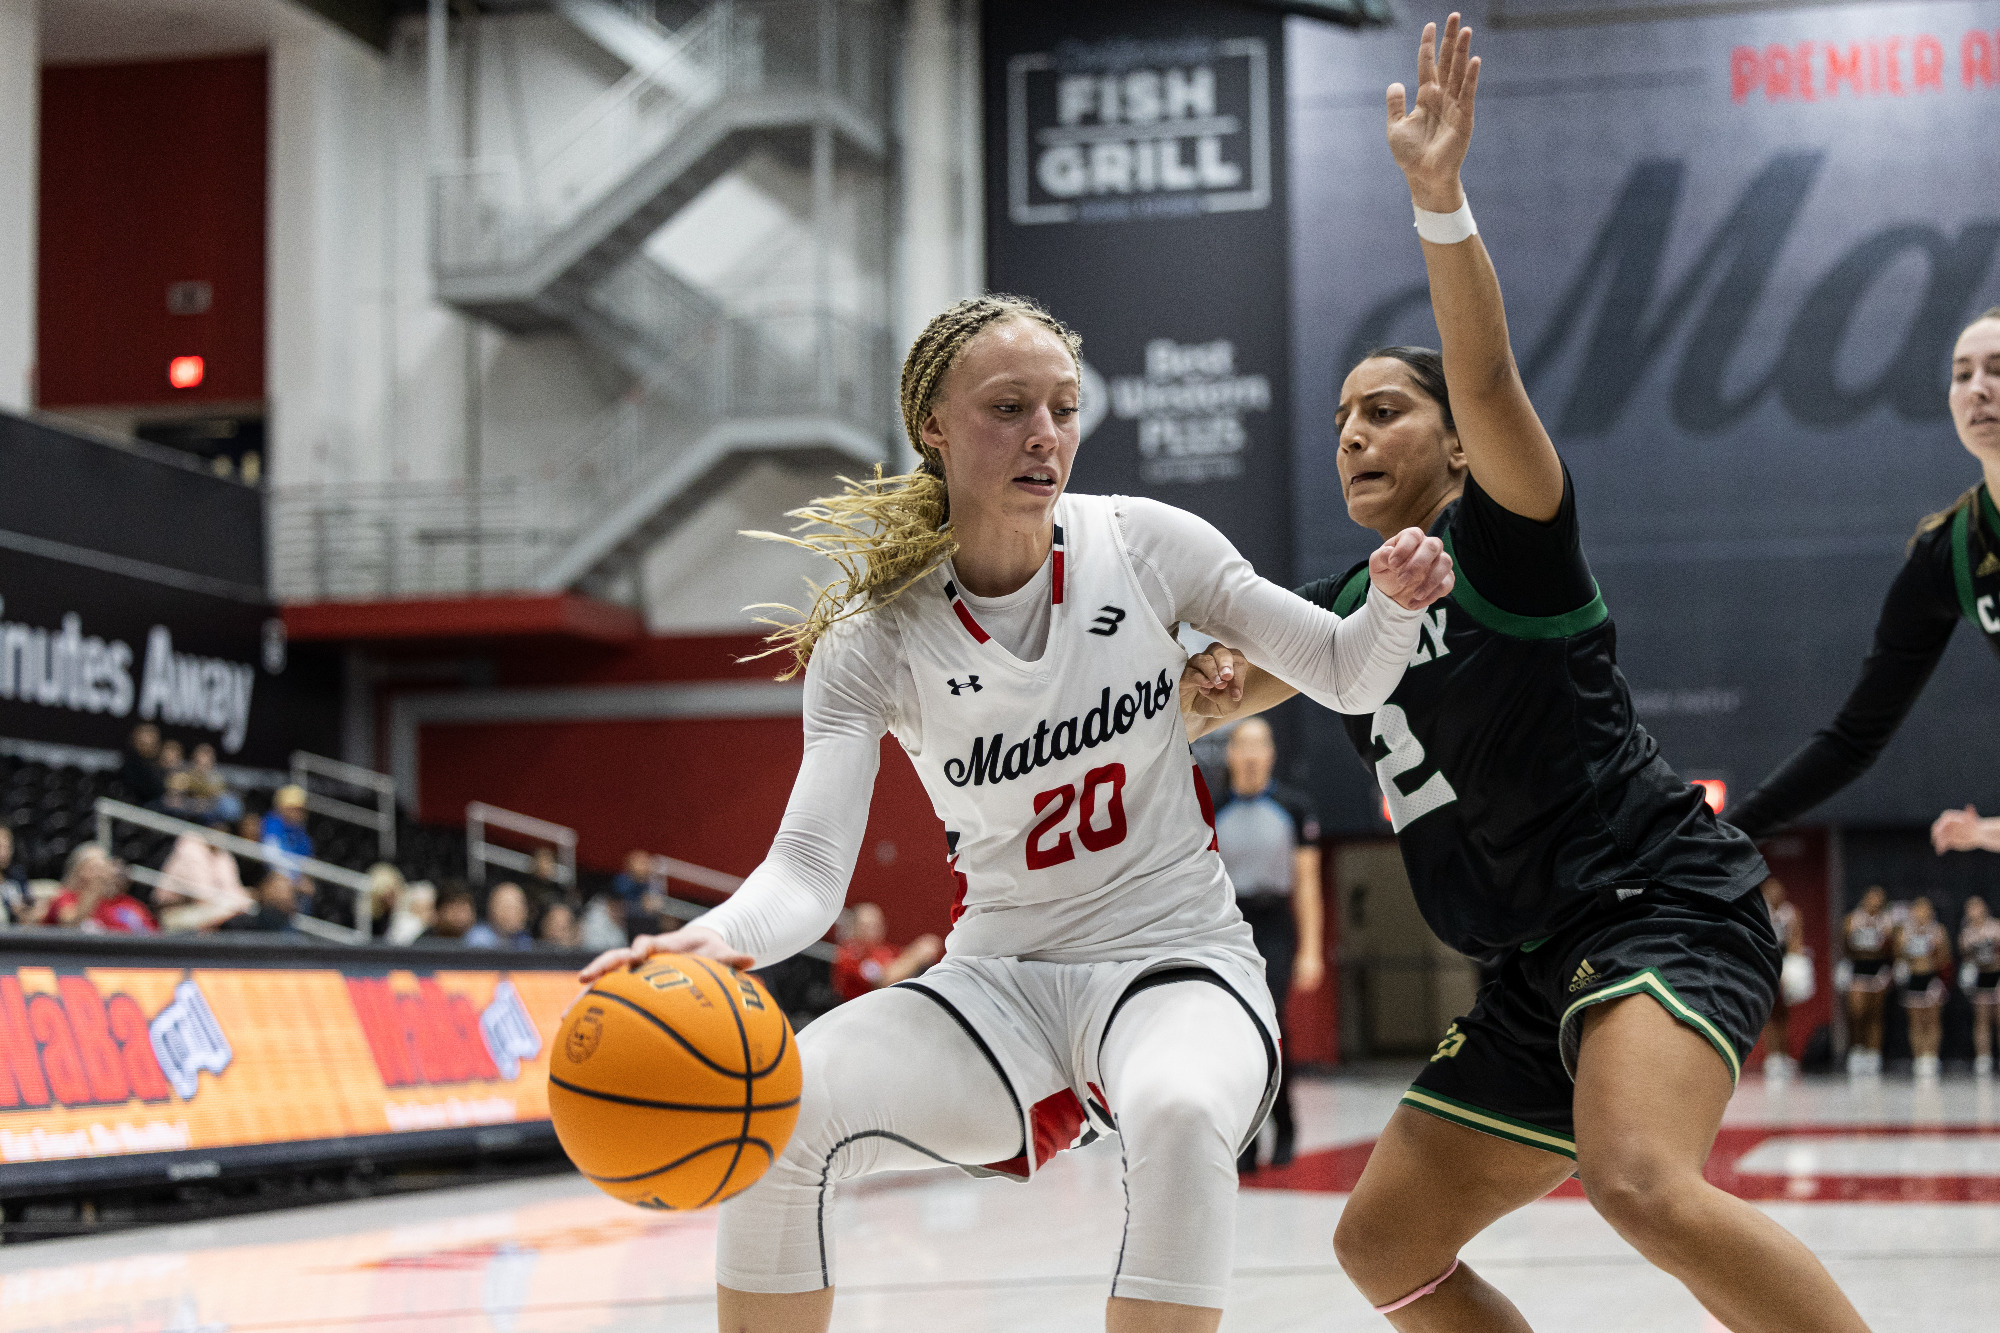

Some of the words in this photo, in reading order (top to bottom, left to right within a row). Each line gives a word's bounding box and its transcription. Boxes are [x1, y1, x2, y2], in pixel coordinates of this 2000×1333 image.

[1056, 67, 1217, 125] FISH
[1731, 34, 1944, 105] PREMIER
[1961, 27, 2000, 90] A
[1036, 138, 1242, 198] GRILL
[1111, 375, 1271, 419] Western
[0, 594, 134, 718] nutes
[137, 623, 255, 754] Away
[944, 668, 1173, 787] Matadors
[1370, 704, 1457, 834] 2
[1025, 762, 1128, 870] 20
[1568, 973, 1602, 993] adidas
